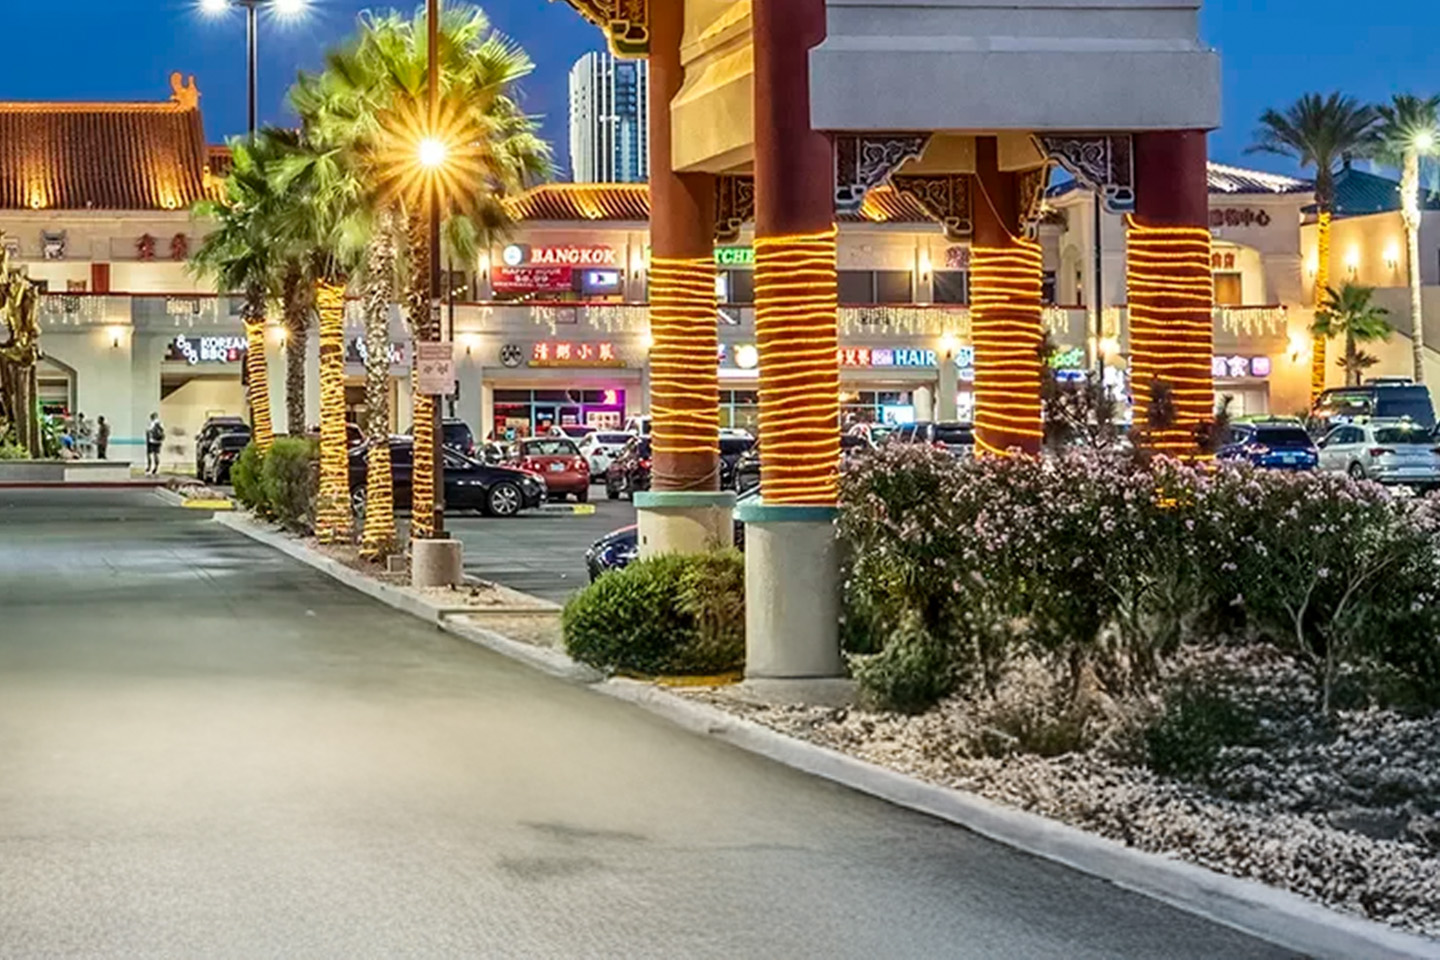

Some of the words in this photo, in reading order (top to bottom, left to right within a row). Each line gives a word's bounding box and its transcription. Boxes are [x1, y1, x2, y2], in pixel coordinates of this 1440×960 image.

[531, 248, 617, 264] BANGKOK
[201, 337, 248, 349] KOREAN
[894, 348, 937, 367] HAIR
